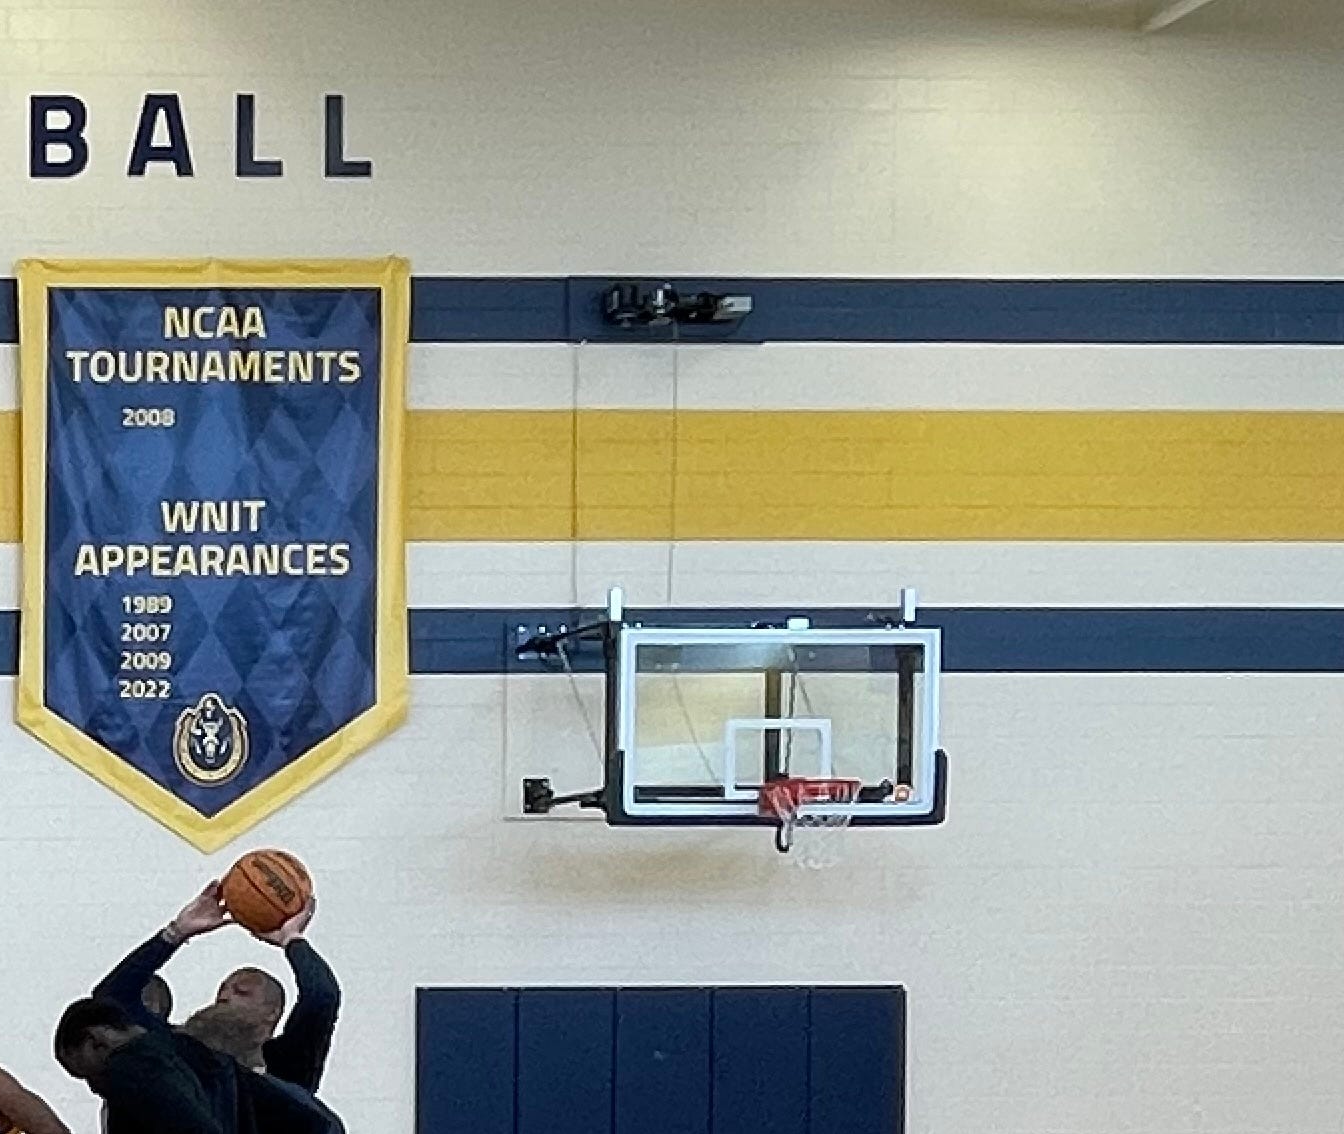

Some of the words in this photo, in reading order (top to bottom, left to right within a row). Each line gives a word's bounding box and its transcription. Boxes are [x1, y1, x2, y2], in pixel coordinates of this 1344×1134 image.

[164, 306, 266, 338] NCAA
[66, 350, 360, 384] TOURNAMENTS
[122, 408, 175, 426] 2008
[160, 500, 266, 534] WNIT
[74, 543, 350, 576] APPEARANCES
[122, 596, 172, 614] 1989
[120, 622, 172, 642] 2007
[120, 650, 172, 670] 2009
[118, 679, 171, 698] 2022
